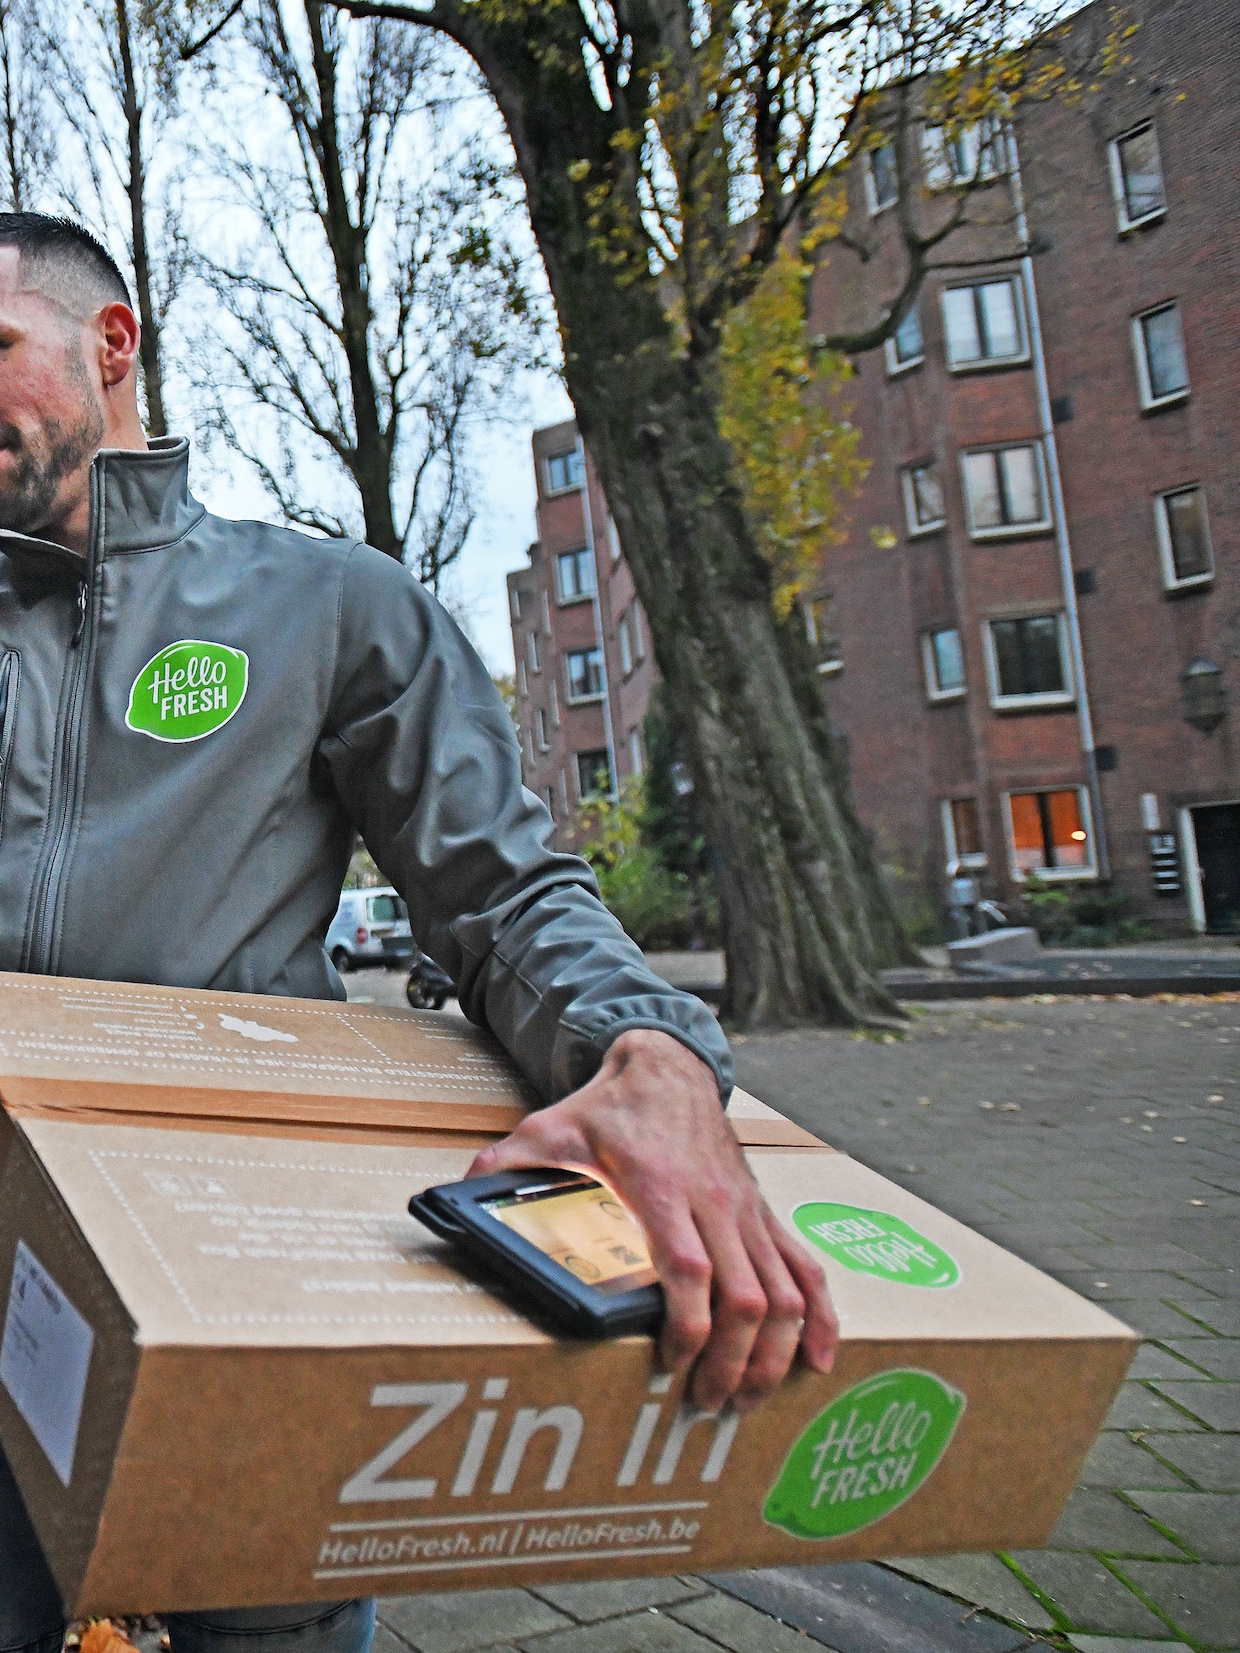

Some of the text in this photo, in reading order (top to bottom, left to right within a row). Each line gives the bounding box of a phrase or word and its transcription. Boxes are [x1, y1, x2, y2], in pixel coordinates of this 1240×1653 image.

[148, 656, 226, 704] Hello
[161, 685, 228, 721] FRESH
[808, 1217, 888, 1246] FRESH
[339, 1373, 740, 1503] Zin in
[811, 1401, 932, 1480] Hello
[811, 1452, 918, 1509] FRESH
